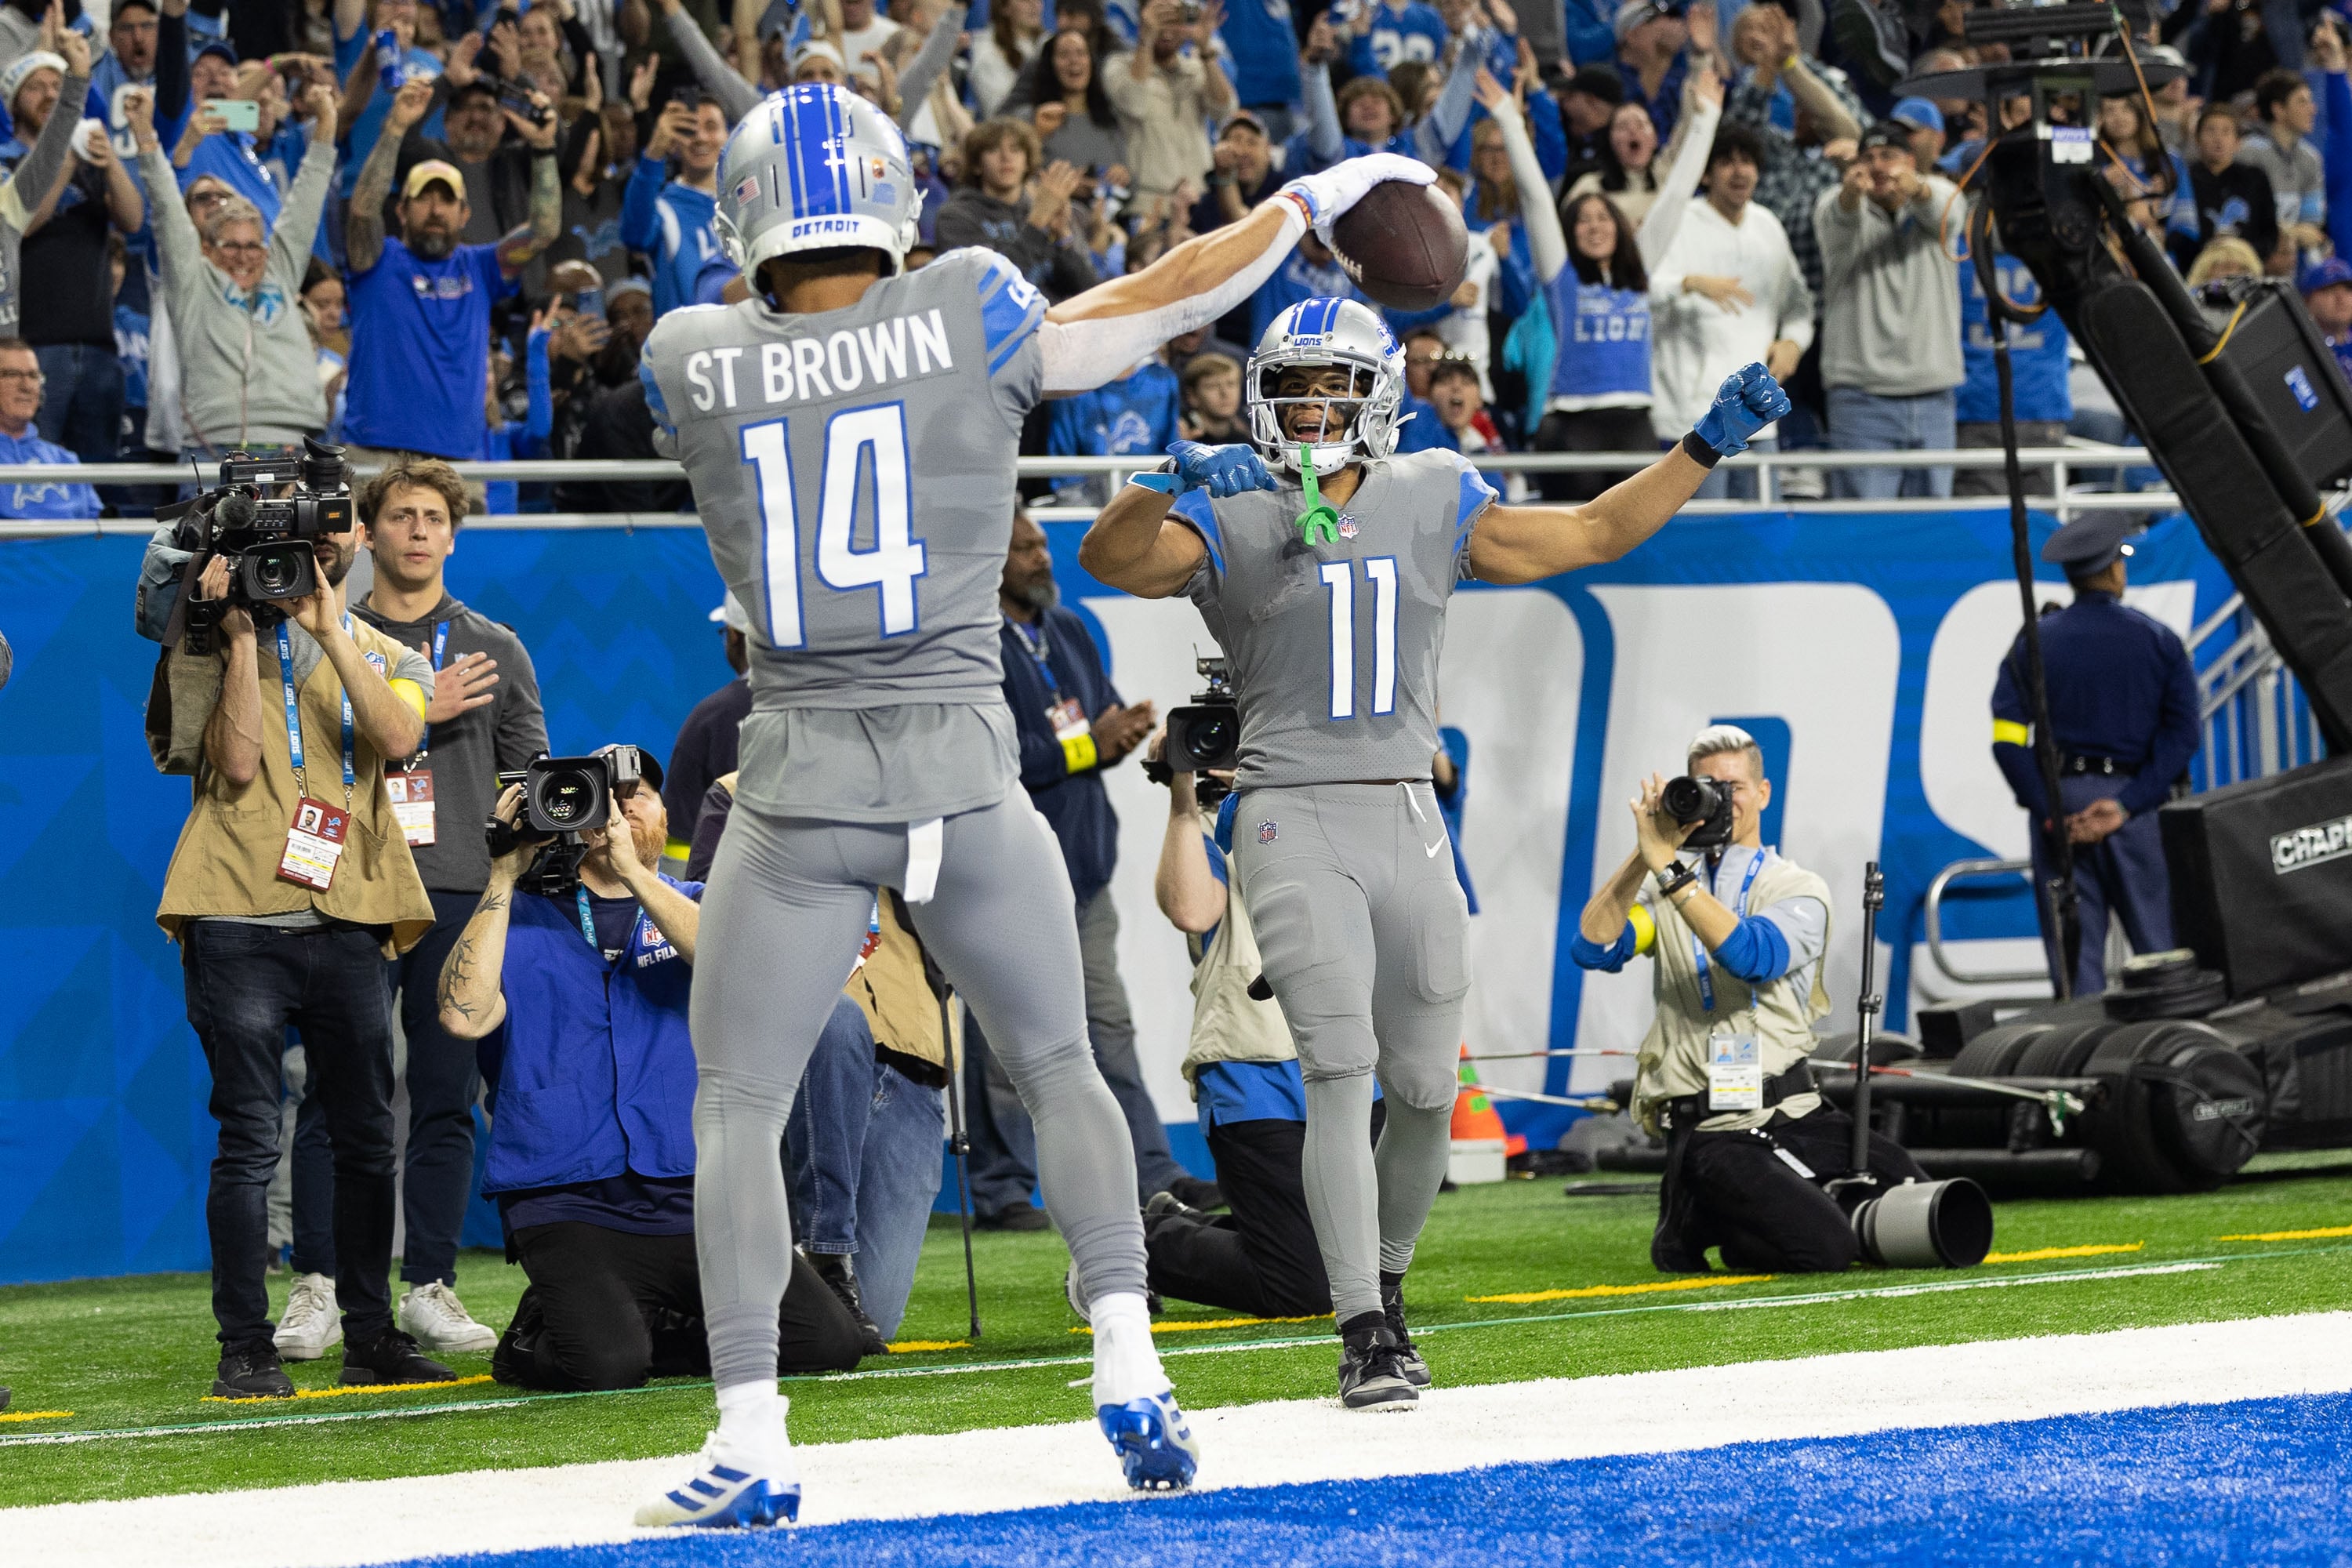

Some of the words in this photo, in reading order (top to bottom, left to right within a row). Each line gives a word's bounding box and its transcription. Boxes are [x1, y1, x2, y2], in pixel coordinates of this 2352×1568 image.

[793, 220, 859, 239] DETROIT
[1294, 337, 1323, 347] LIONS
[687, 347, 743, 412] ST
[761, 309, 953, 403] BROWN
[739, 400, 928, 652] 14
[1318, 555, 1399, 720] 11
[279, 640, 290, 661] LIONS
[285, 683, 296, 706] LIONS
[290, 730, 301, 754] LIONS
[637, 953, 655, 968] NFL
